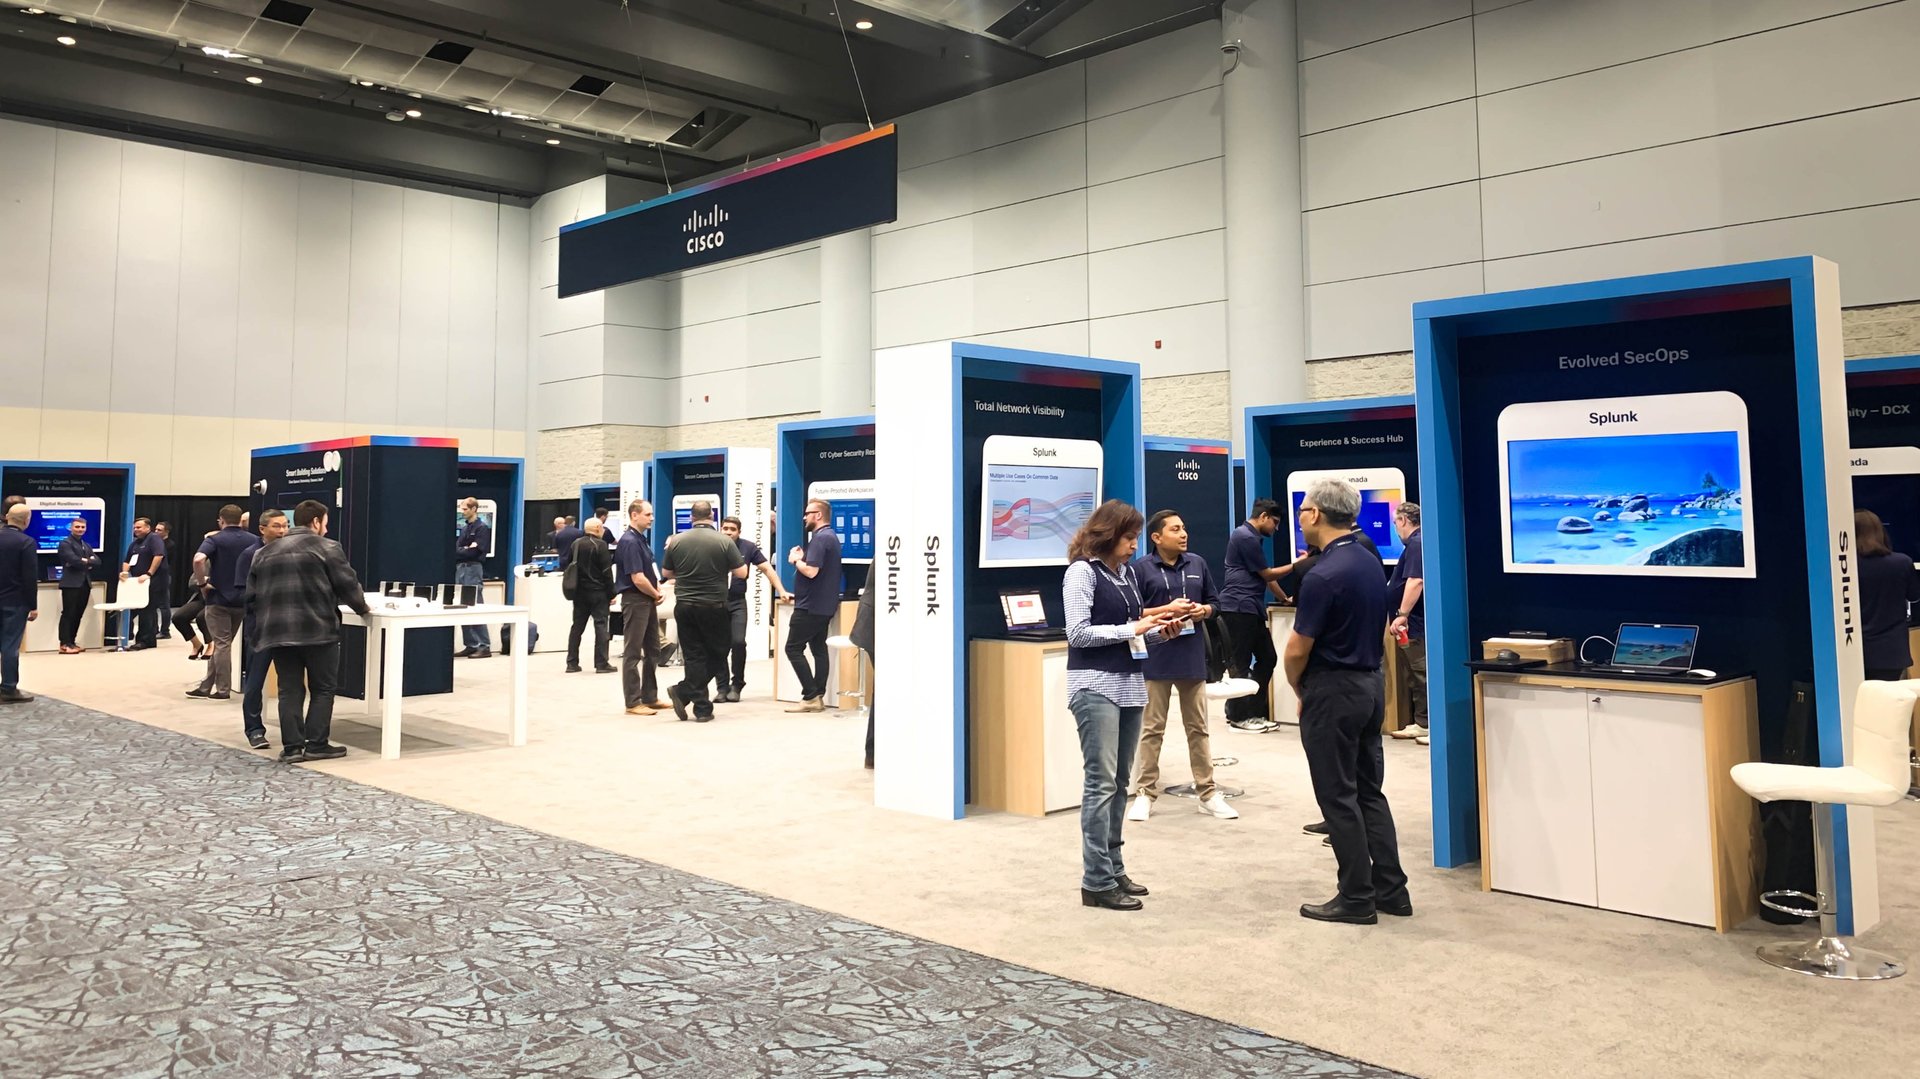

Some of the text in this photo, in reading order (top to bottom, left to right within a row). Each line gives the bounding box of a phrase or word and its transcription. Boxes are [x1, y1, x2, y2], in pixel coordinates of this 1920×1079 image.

[686, 230, 725, 254] CISCO
[1558, 348, 1690, 370] Evolved SecOps
[974, 400, 1065, 418] Total Network Visibility
[1882, 404, 1911, 415] DCX
[1589, 411, 1639, 426] Splunk
[1300, 434, 1404, 448] Experience & Success Hub
[820, 451, 827, 459] OT
[828, 451, 843, 459] Cyber
[1032, 447, 1057, 458] Splunk
[286, 469, 296, 477] Smart
[1178, 471, 1199, 480] CISCO
[886, 535, 901, 615] Splunk
[923, 535, 940, 616] Splunk
[1838, 530, 1854, 647] Splunk
